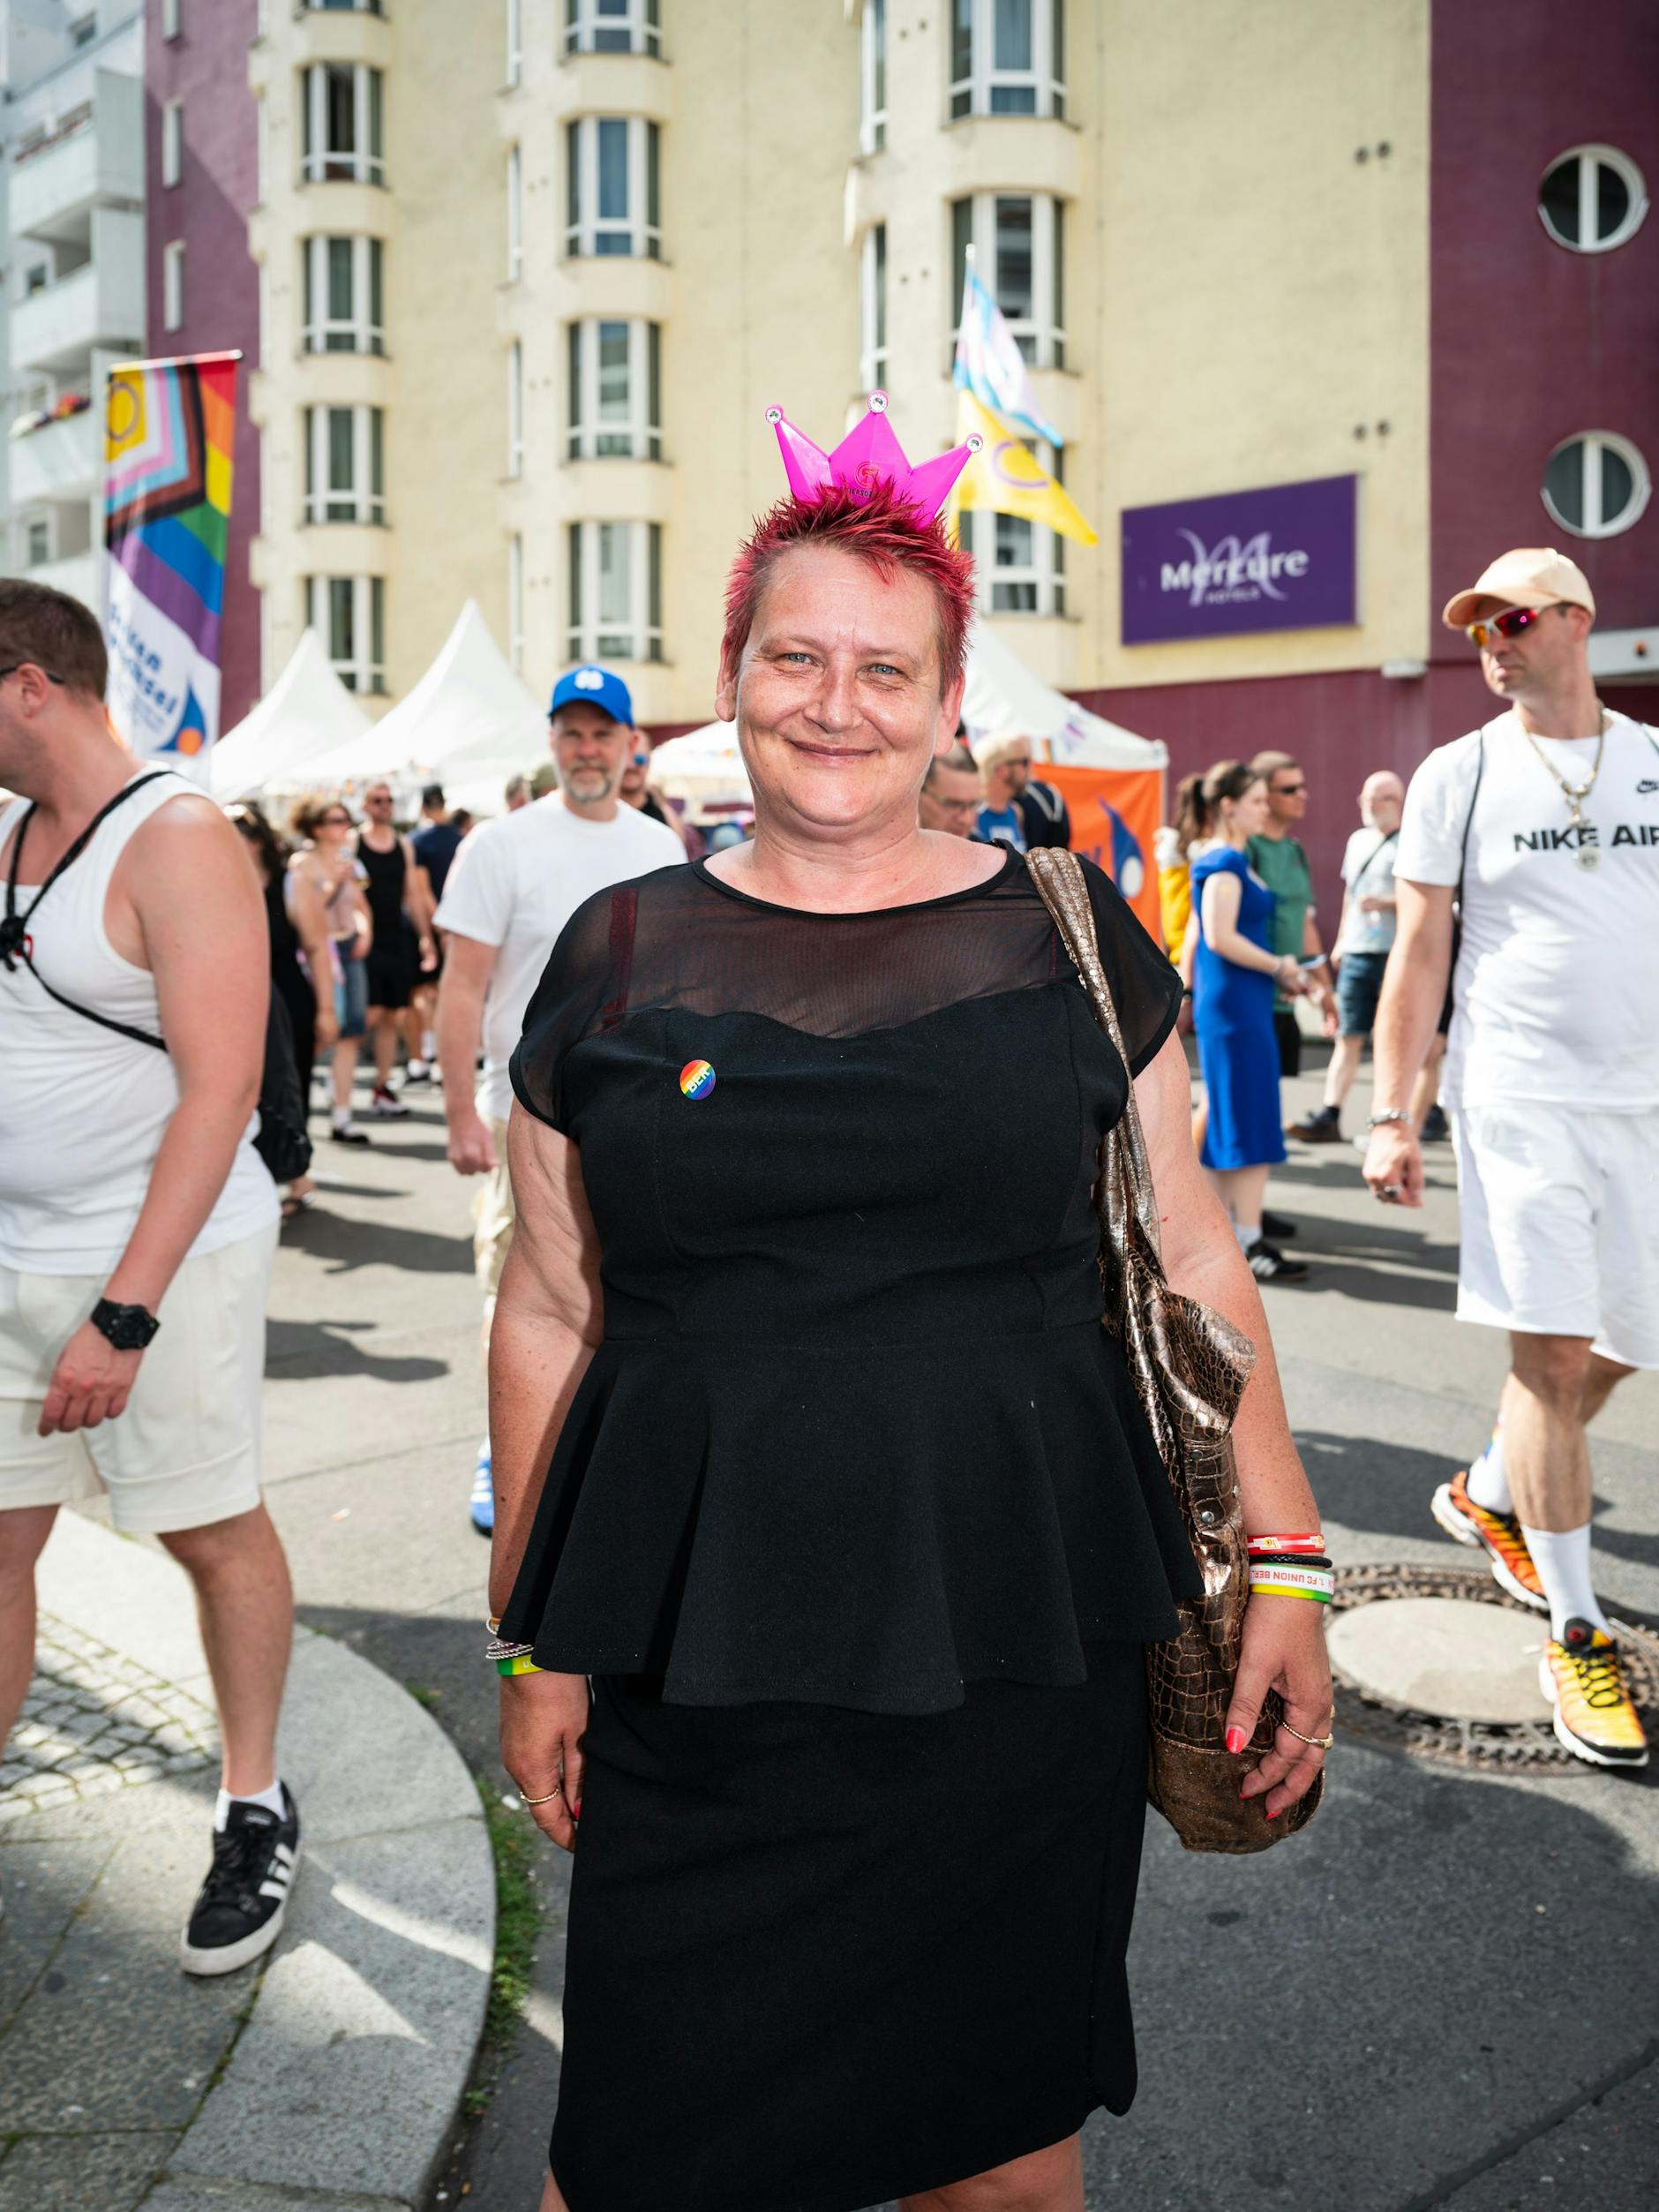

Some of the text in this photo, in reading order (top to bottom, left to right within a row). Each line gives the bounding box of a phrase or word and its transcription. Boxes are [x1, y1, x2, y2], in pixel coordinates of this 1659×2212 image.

[1160, 550, 1309, 591] Mercure
[1513, 827, 1599, 852] NIKE
[685, 1065, 710, 1094] BER
[1272, 1571, 1305, 1583] UNION
[1307, 1576, 1317, 1585] FC
